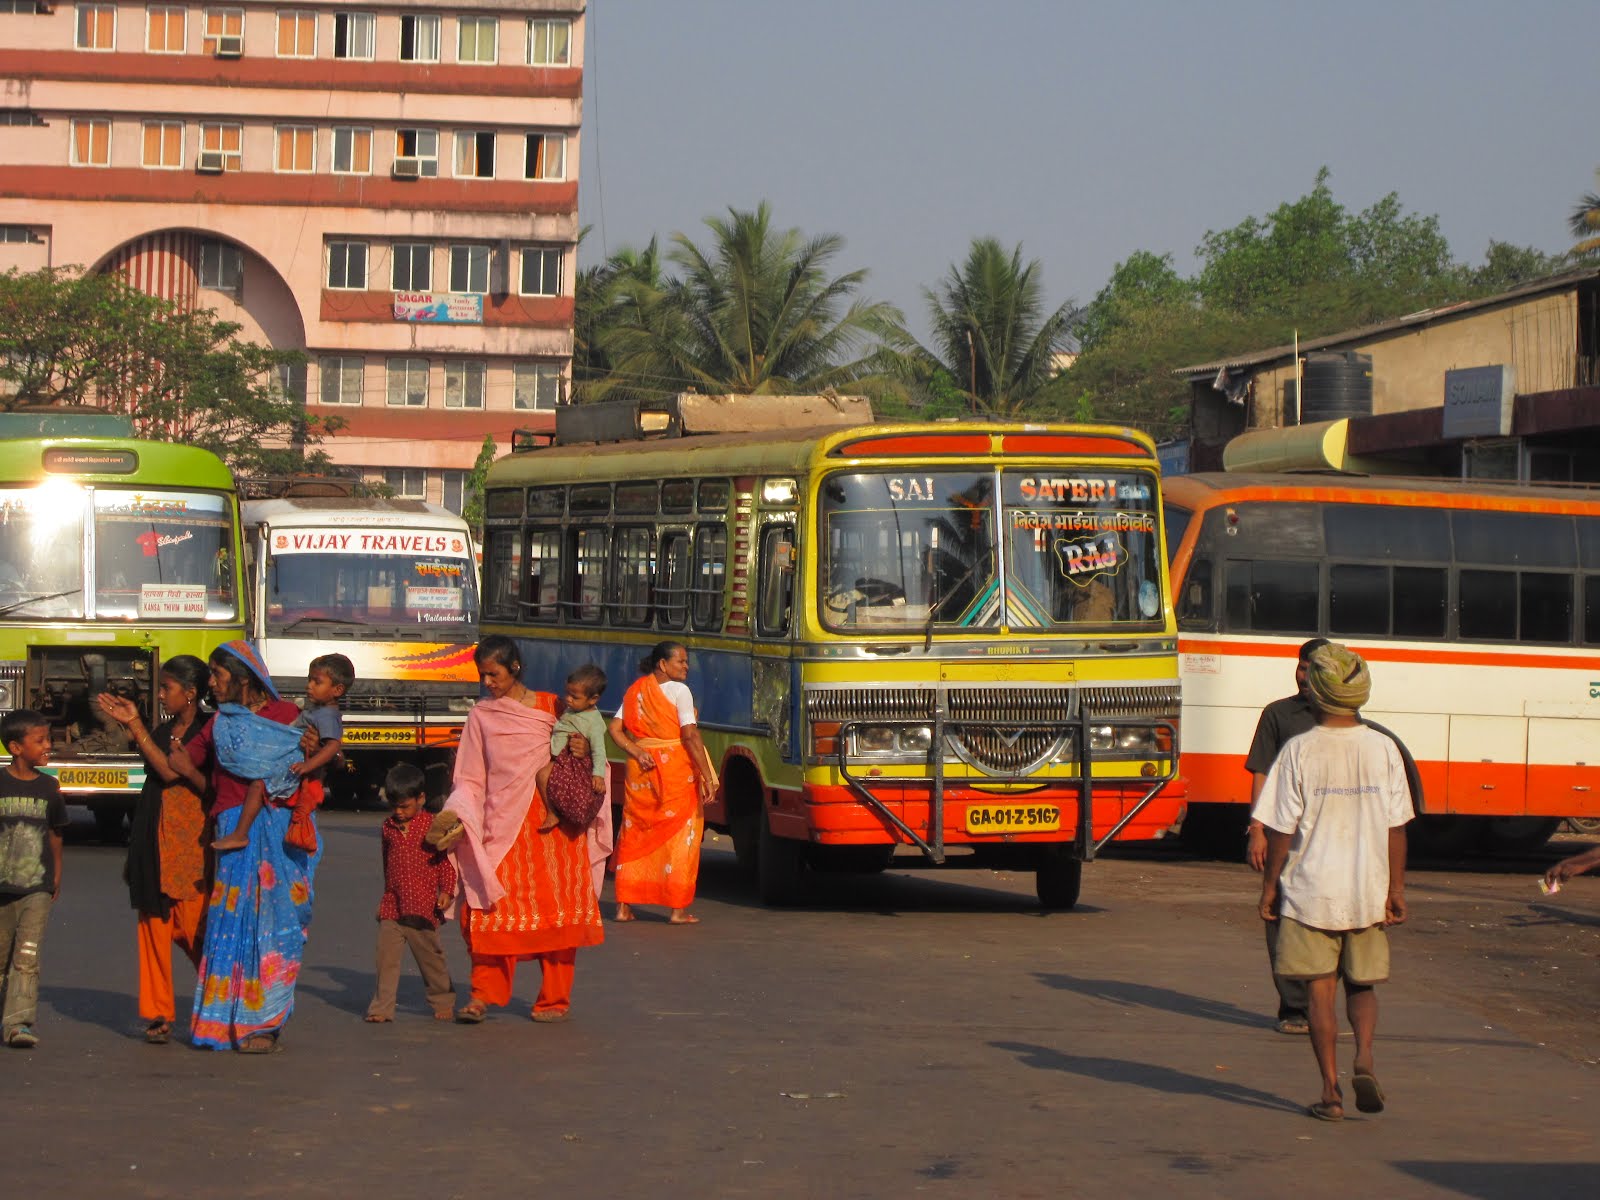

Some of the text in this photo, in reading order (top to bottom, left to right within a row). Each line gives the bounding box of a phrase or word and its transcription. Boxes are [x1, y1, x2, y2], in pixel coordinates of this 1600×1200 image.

[397, 293, 432, 303] SAGAR
[889, 478, 934, 501] SAI
[1019, 478, 1117, 502] SATERI
[293, 534, 447, 552] VIJAY TRAVELS
[1063, 538, 1117, 575] RAJ
[144, 603, 160, 612] KANSA
[184, 603, 204, 613] MAPUSA
[987, 647, 1030, 655] BHUMIKA
[969, 807, 1060, 826] GA-01-Z-5167
